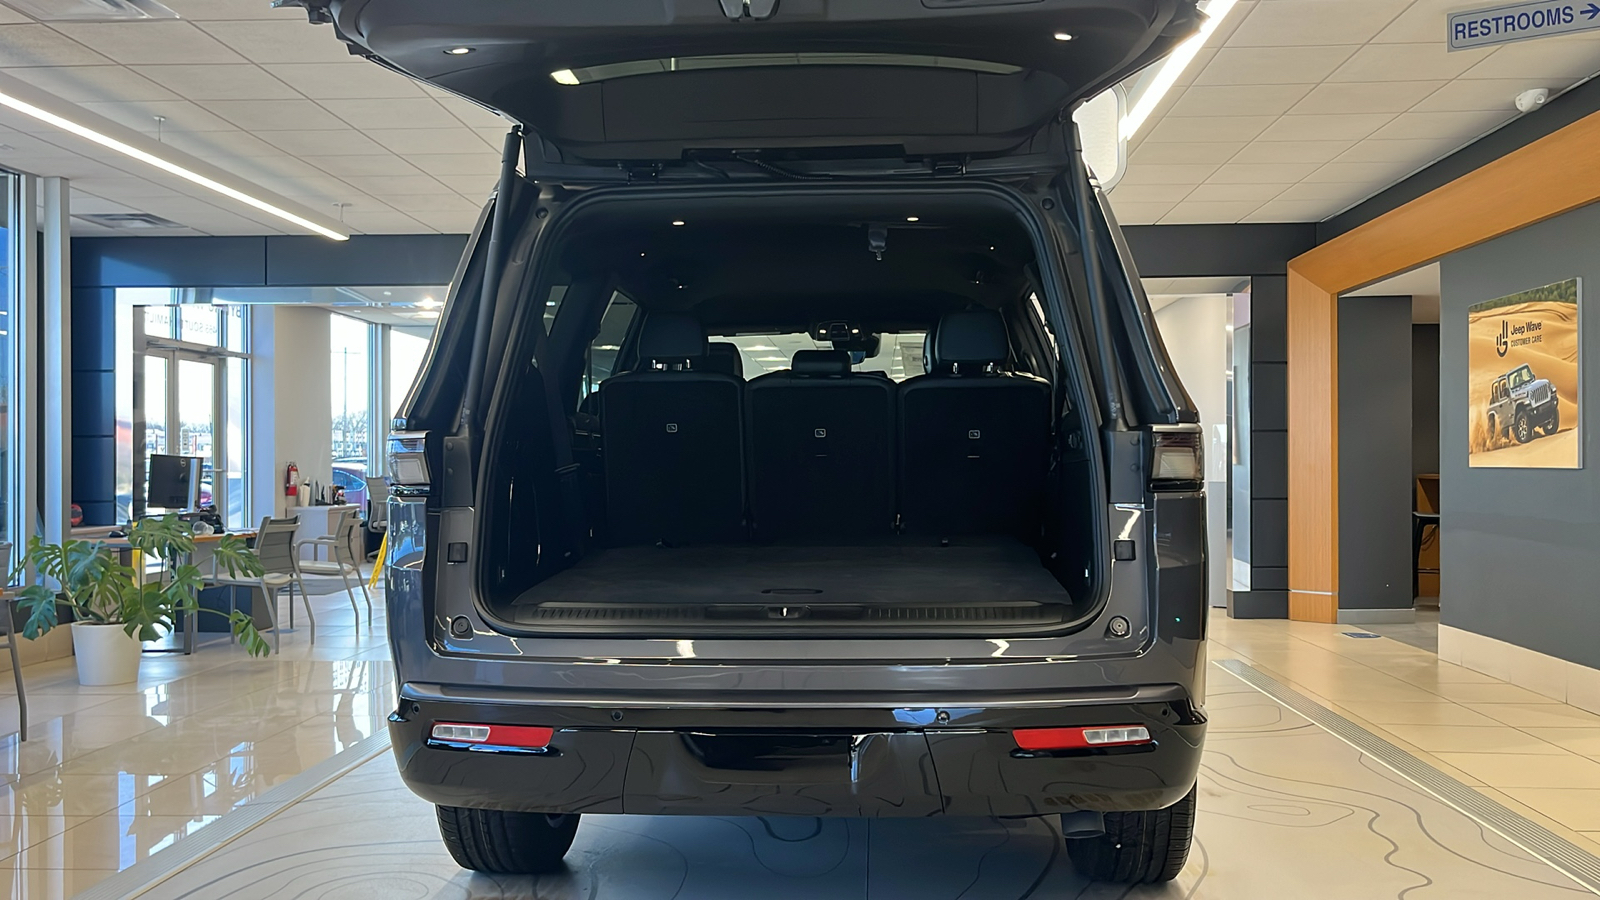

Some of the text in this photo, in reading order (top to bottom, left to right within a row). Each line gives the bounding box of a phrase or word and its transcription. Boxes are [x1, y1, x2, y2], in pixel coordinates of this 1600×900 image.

[1454, 6, 1574, 40] RESTROOMS
[1511, 321, 1542, 335] Jeep Wave
[1511, 334, 1542, 347] CUSTOMER CARE
